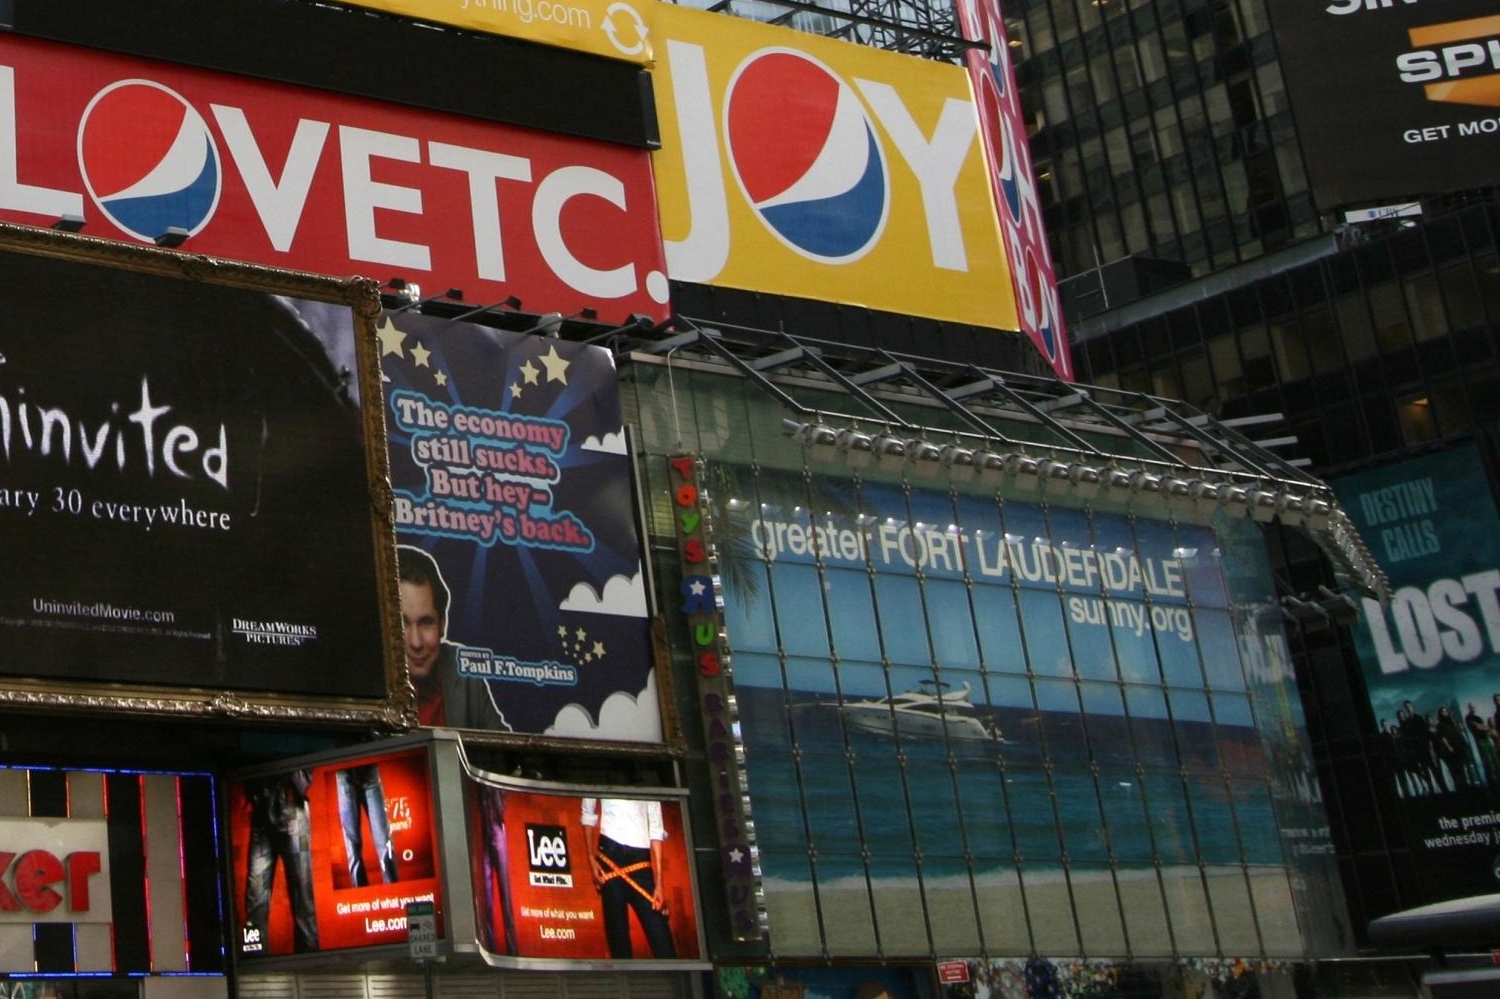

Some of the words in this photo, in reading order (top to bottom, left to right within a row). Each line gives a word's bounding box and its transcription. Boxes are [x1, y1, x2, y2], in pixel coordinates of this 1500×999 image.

[1403, 125, 1451, 143] GET
[1457, 118, 1500, 137] MO
[666, 39, 978, 281] JOY
[397, 397, 448, 428] The
[453, 412, 566, 450] economy
[416, 436, 470, 465] still
[474, 447, 555, 476] sucks.
[431, 468, 481, 498] But
[51, 486, 82, 514] 30
[91, 498, 231, 531] everywhere
[1358, 476, 1438, 527] DESTINY
[393, 497, 516, 540] Britney's
[519, 513, 590, 546] back.
[1380, 518, 1442, 563] CALLS
[750, 518, 875, 562] greater
[878, 524, 969, 573] FORT
[975, 531, 1188, 599] LAUDERDALE
[32, 597, 175, 624] UninvitedMovie.com
[1069, 595, 1193, 642] sunny.org
[1361, 569, 1500, 675] LOST
[246, 633, 301, 647] PICTURES
[460, 657, 492, 674] Paul
[506, 662, 574, 681] Tompkins
[1424, 830, 1491, 849] wednesday
[1439, 816, 1459, 830] the
[527, 829, 567, 868] Lee
[337, 902, 351, 915] Get
[352, 900, 372, 914] more
[372, 898, 381, 911] of
[381, 896, 400, 910] what
[566, 910, 578, 920] you
[243, 927, 260, 944] Lee
[540, 924, 576, 940] Lee.com
